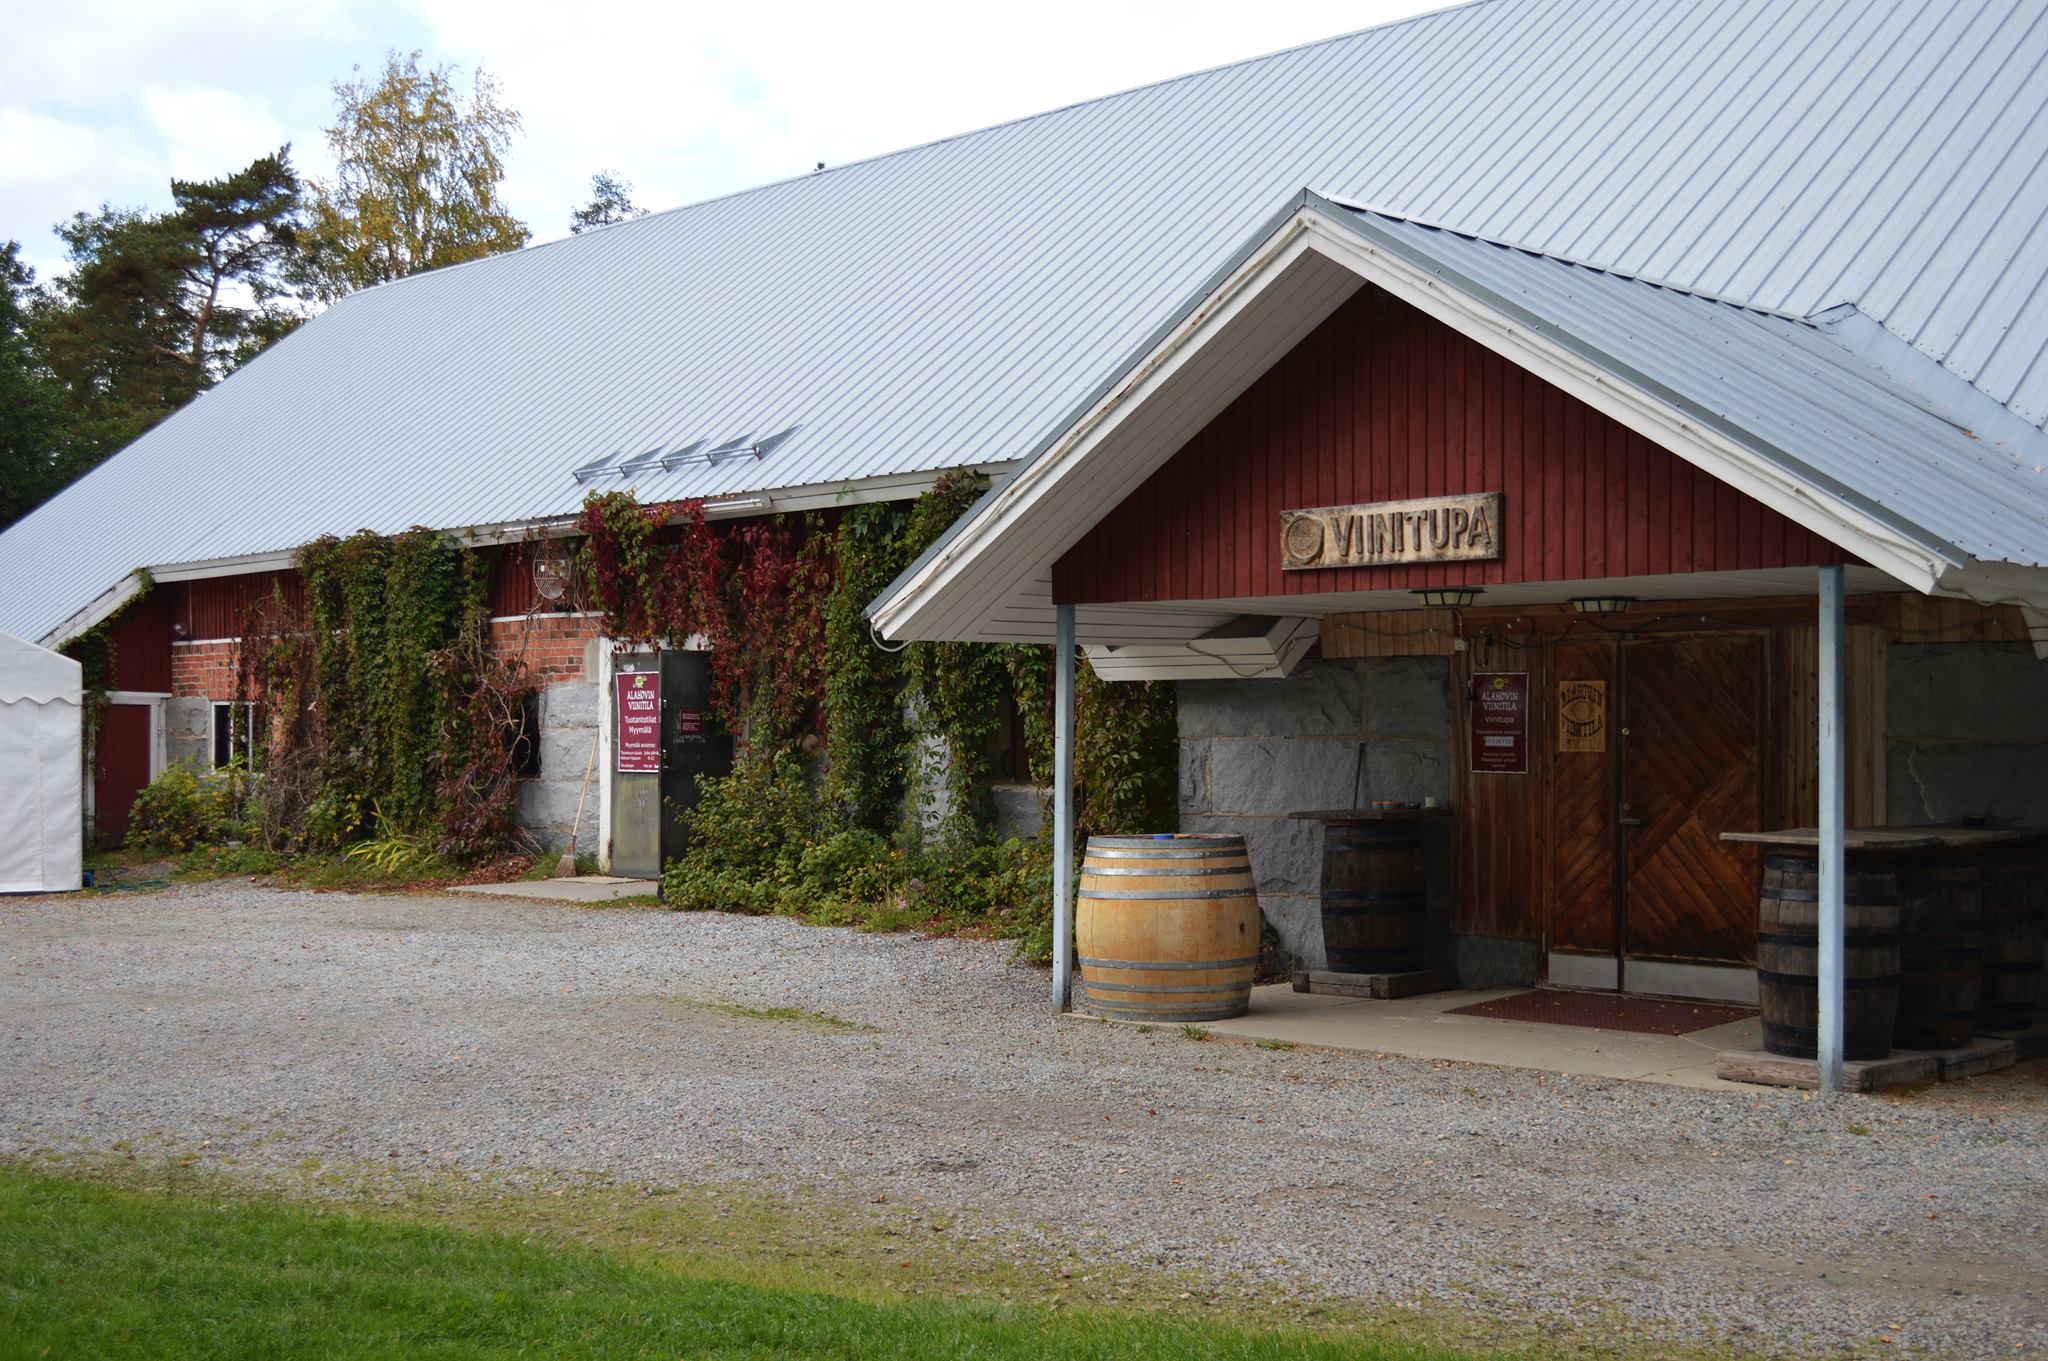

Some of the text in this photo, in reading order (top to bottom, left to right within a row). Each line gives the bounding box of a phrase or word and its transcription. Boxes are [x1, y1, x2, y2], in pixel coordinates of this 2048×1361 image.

[1329, 506, 1492, 556] VIINITUPA
[626, 690, 655, 700] ALAHOVIN
[1481, 691, 1518, 701] ALAHOVIN
[627, 700, 654, 710] VIINITILA
[1482, 701, 1517, 711] VIINITILA
[624, 715, 657, 724] Tuotantotilat
[1484, 715, 1514, 725] Viinitupa
[628, 726, 652, 735] Myymälä
